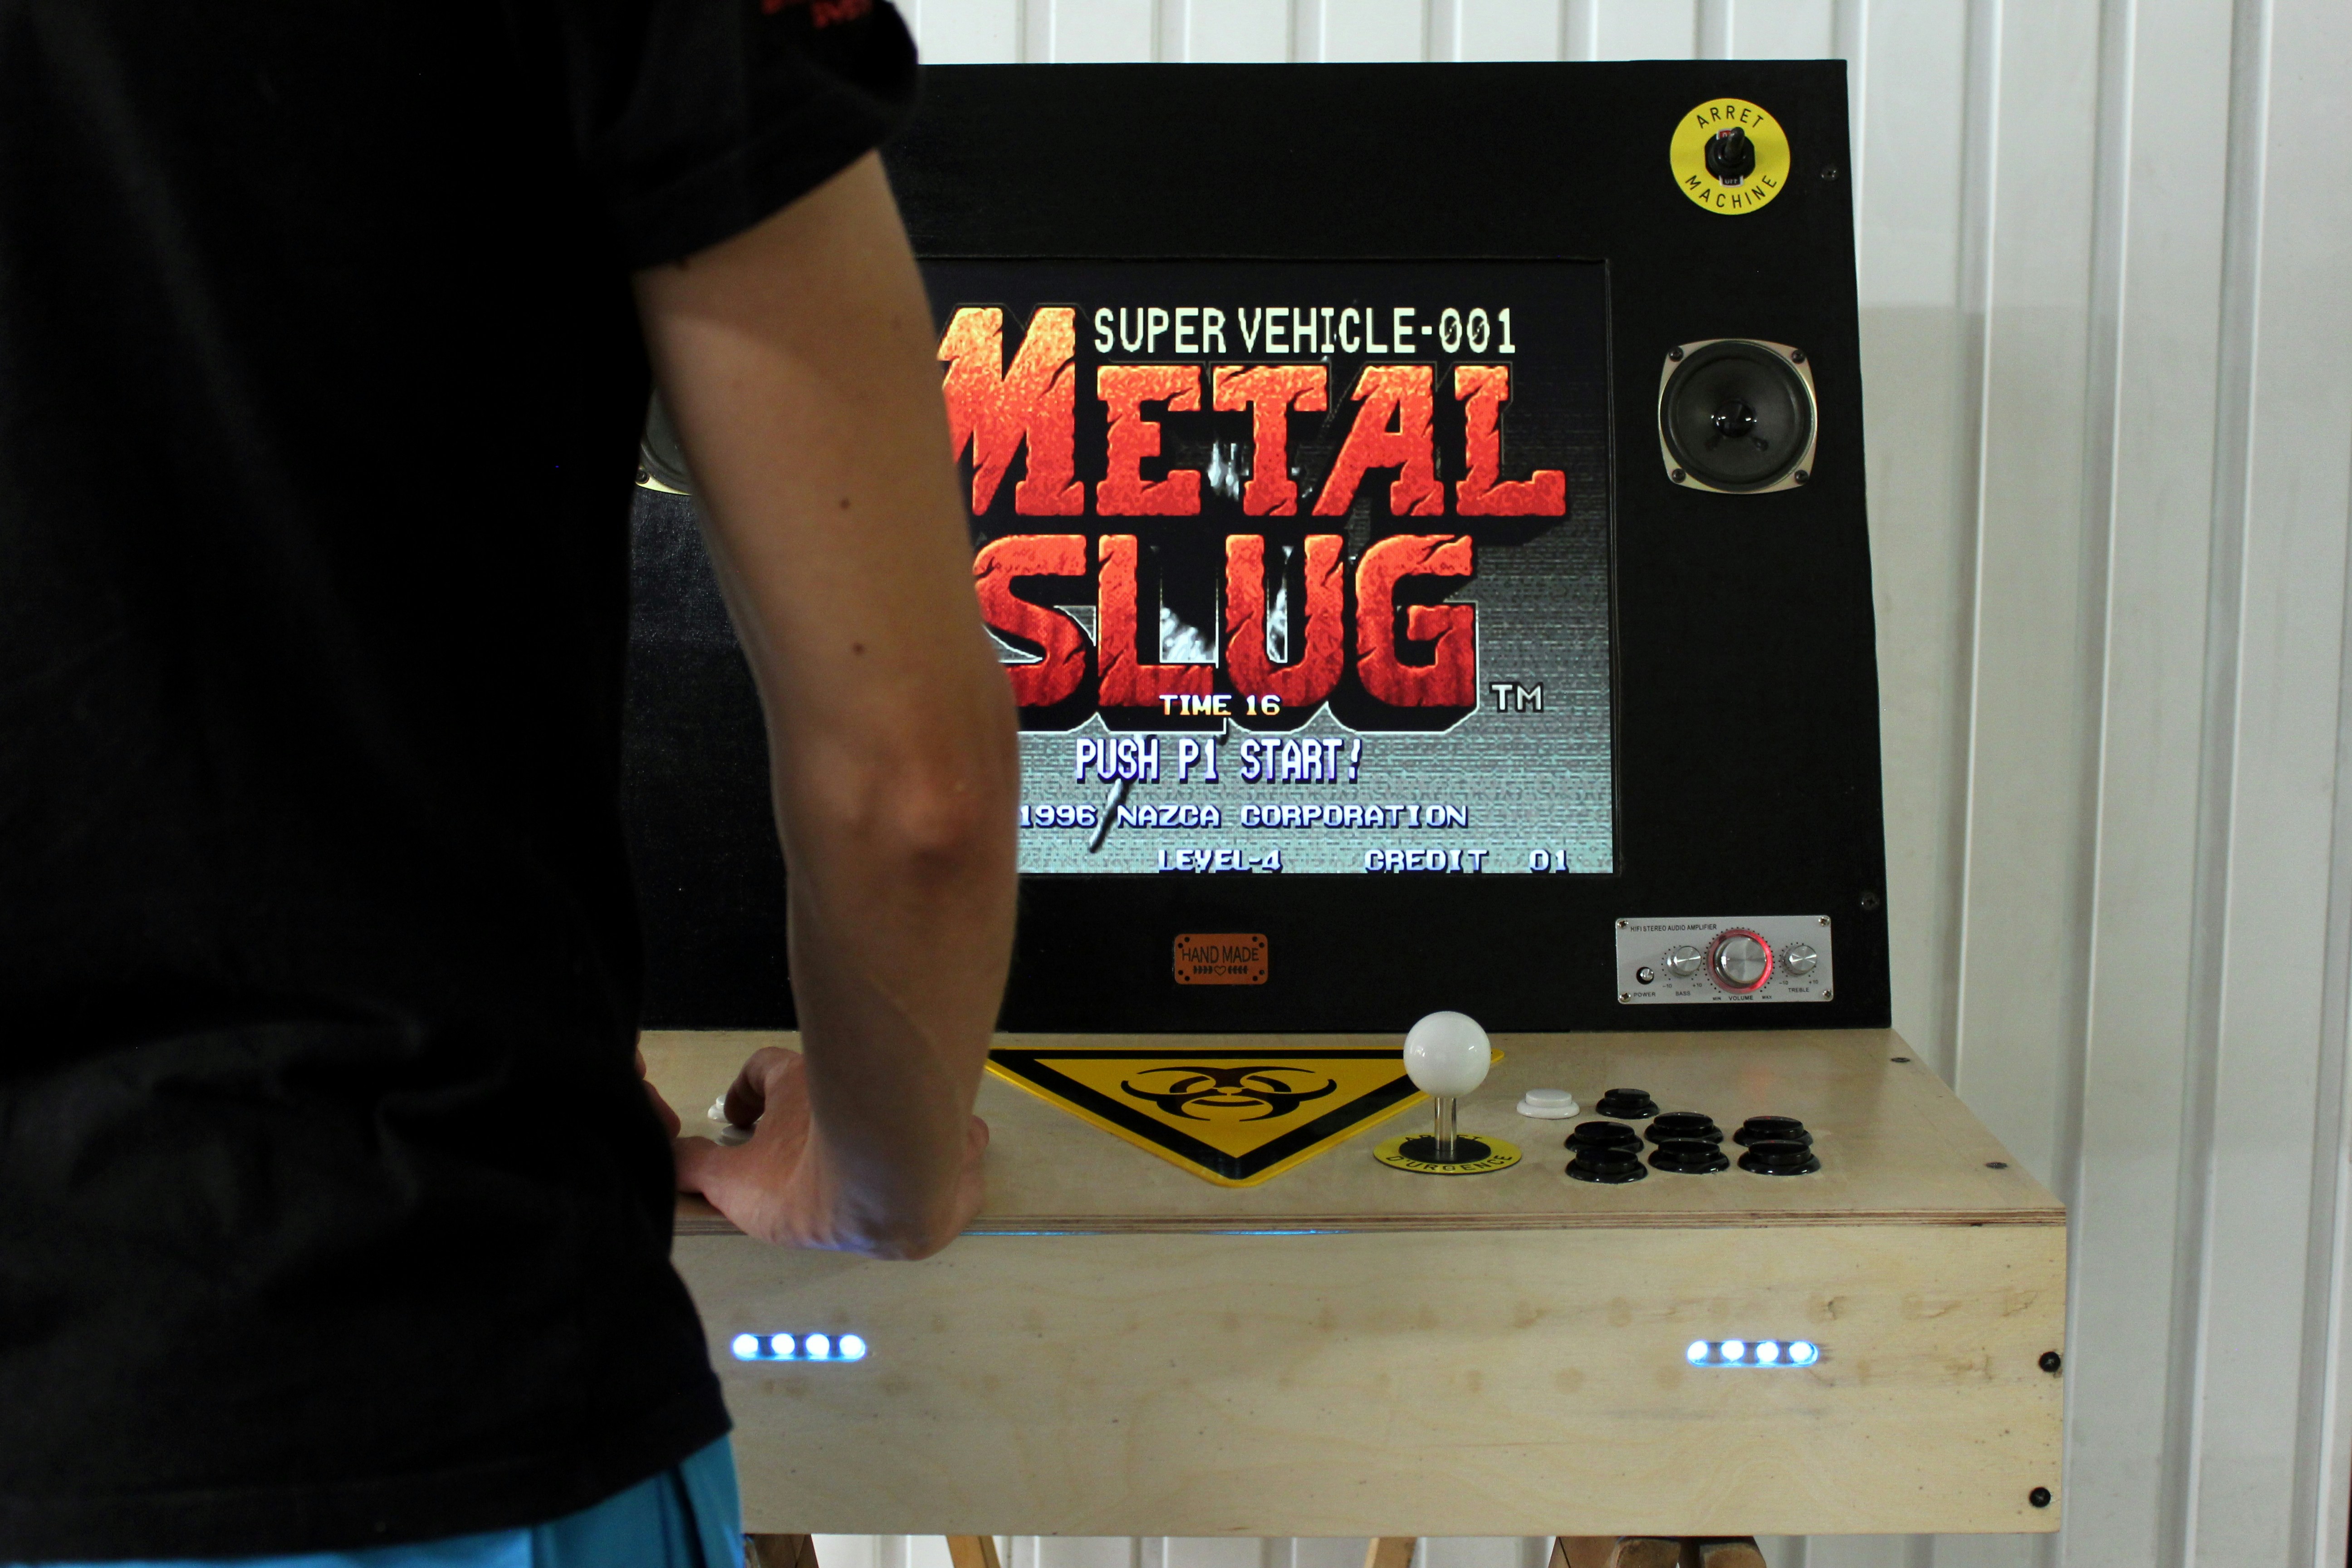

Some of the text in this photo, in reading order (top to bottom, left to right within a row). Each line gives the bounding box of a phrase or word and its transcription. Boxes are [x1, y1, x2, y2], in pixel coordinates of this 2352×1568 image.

[1696, 105, 1764, 128] ARRET
[1685, 175, 1777, 209] MACHINE
[1094, 307, 1516, 353] SUPER VEHICLE-001
[936, 307, 1566, 517] METAL
[974, 533, 1475, 707] SLUG
[1159, 694, 1281, 716] TIME 16
[1075, 738, 1361, 782] PUSH P1 START!
[1020, 804, 1468, 828] 1996 NAZCA CORPORATION
[1158, 849, 1282, 872] LEVEL-4
[1365, 849, 1568, 872] CREDIT 01
[1182, 946, 1259, 963] HAND MADE
[1386, 1155, 1512, 1171] D'URGENCE
